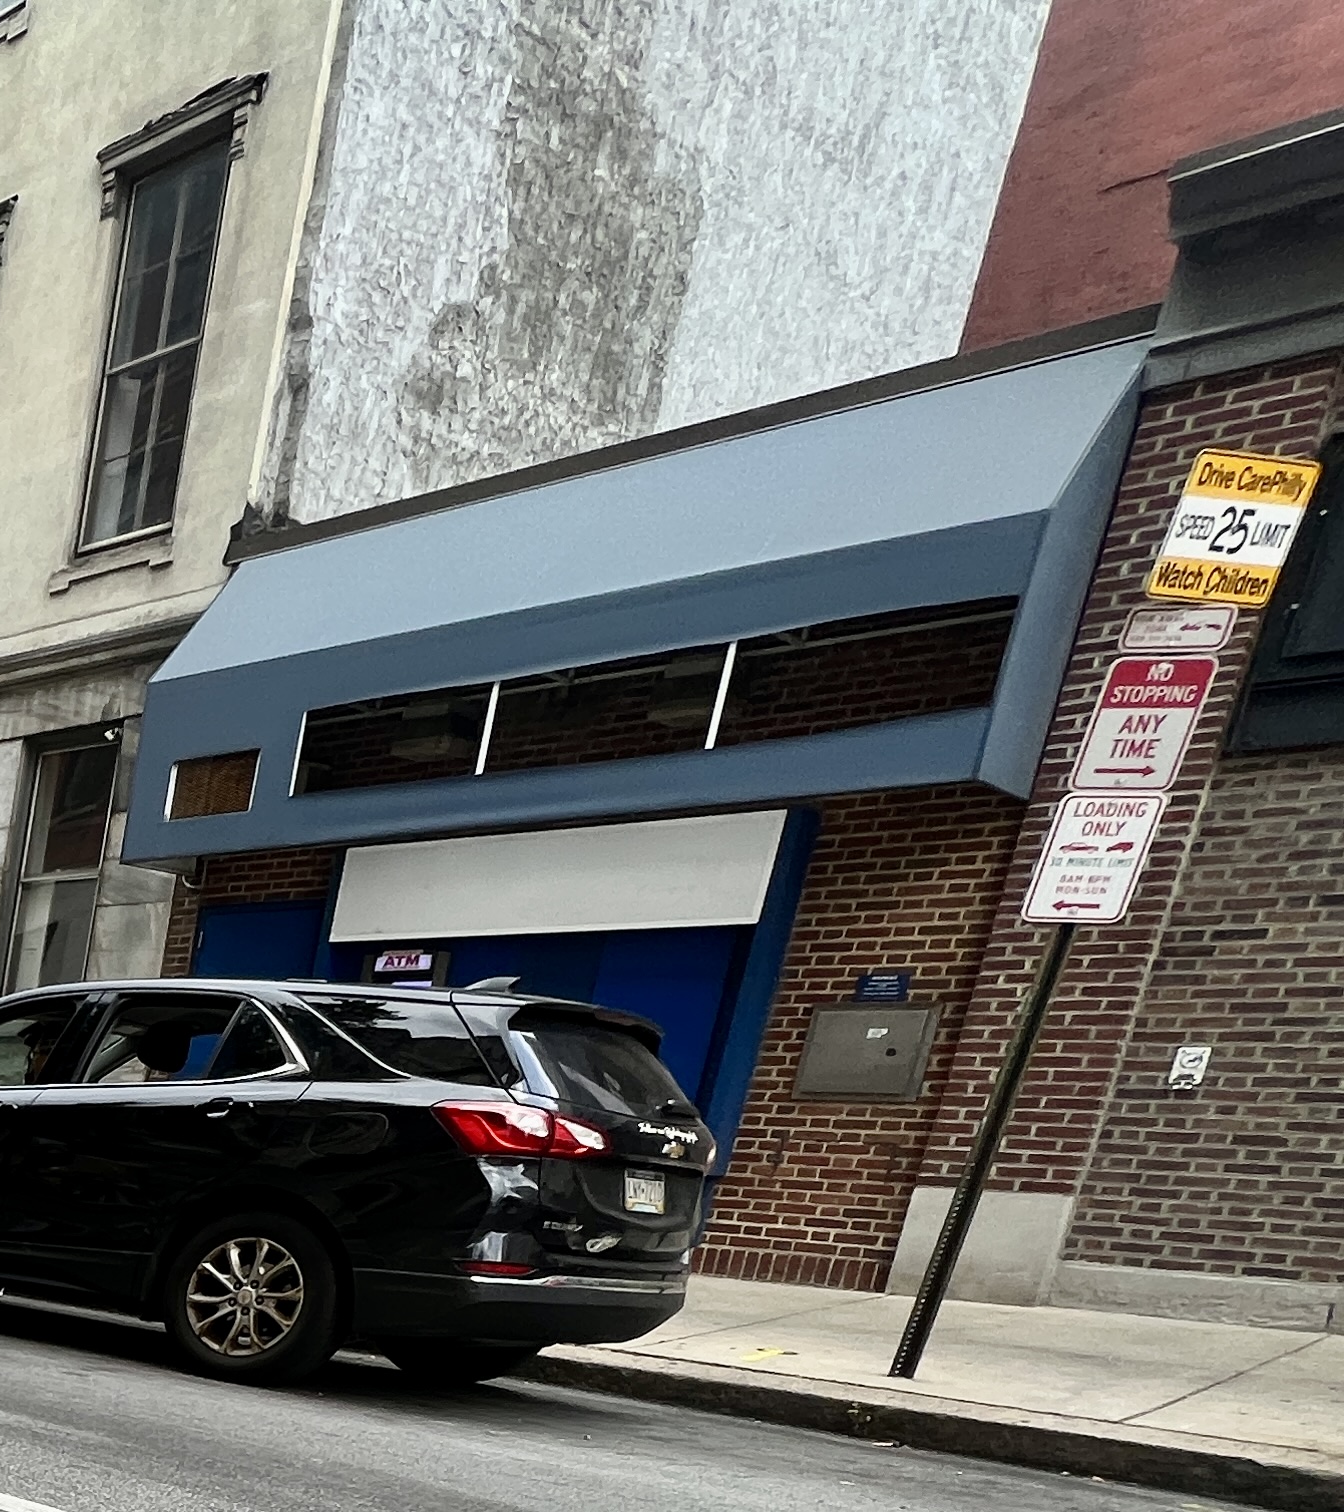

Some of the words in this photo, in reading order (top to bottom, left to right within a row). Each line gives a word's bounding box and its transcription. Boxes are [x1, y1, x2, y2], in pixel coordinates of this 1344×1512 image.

[1197, 462, 1235, 489] Drive
[1175, 514, 1216, 540] SPEED
[1208, 506, 1257, 555] 25
[1249, 520, 1291, 549] LIMIT
[1156, 562, 1203, 591] Watch
[1203, 567, 1269, 597] Children
[1145, 663, 1174, 682] NO
[1110, 684, 1198, 704] STOPPING
[1118, 714, 1166, 734] ANY
[1109, 738, 1161, 759] TIME
[1073, 801, 1147, 818] LOADING
[1081, 821, 1128, 837] ONLY
[383, 954, 421, 967] ATM
